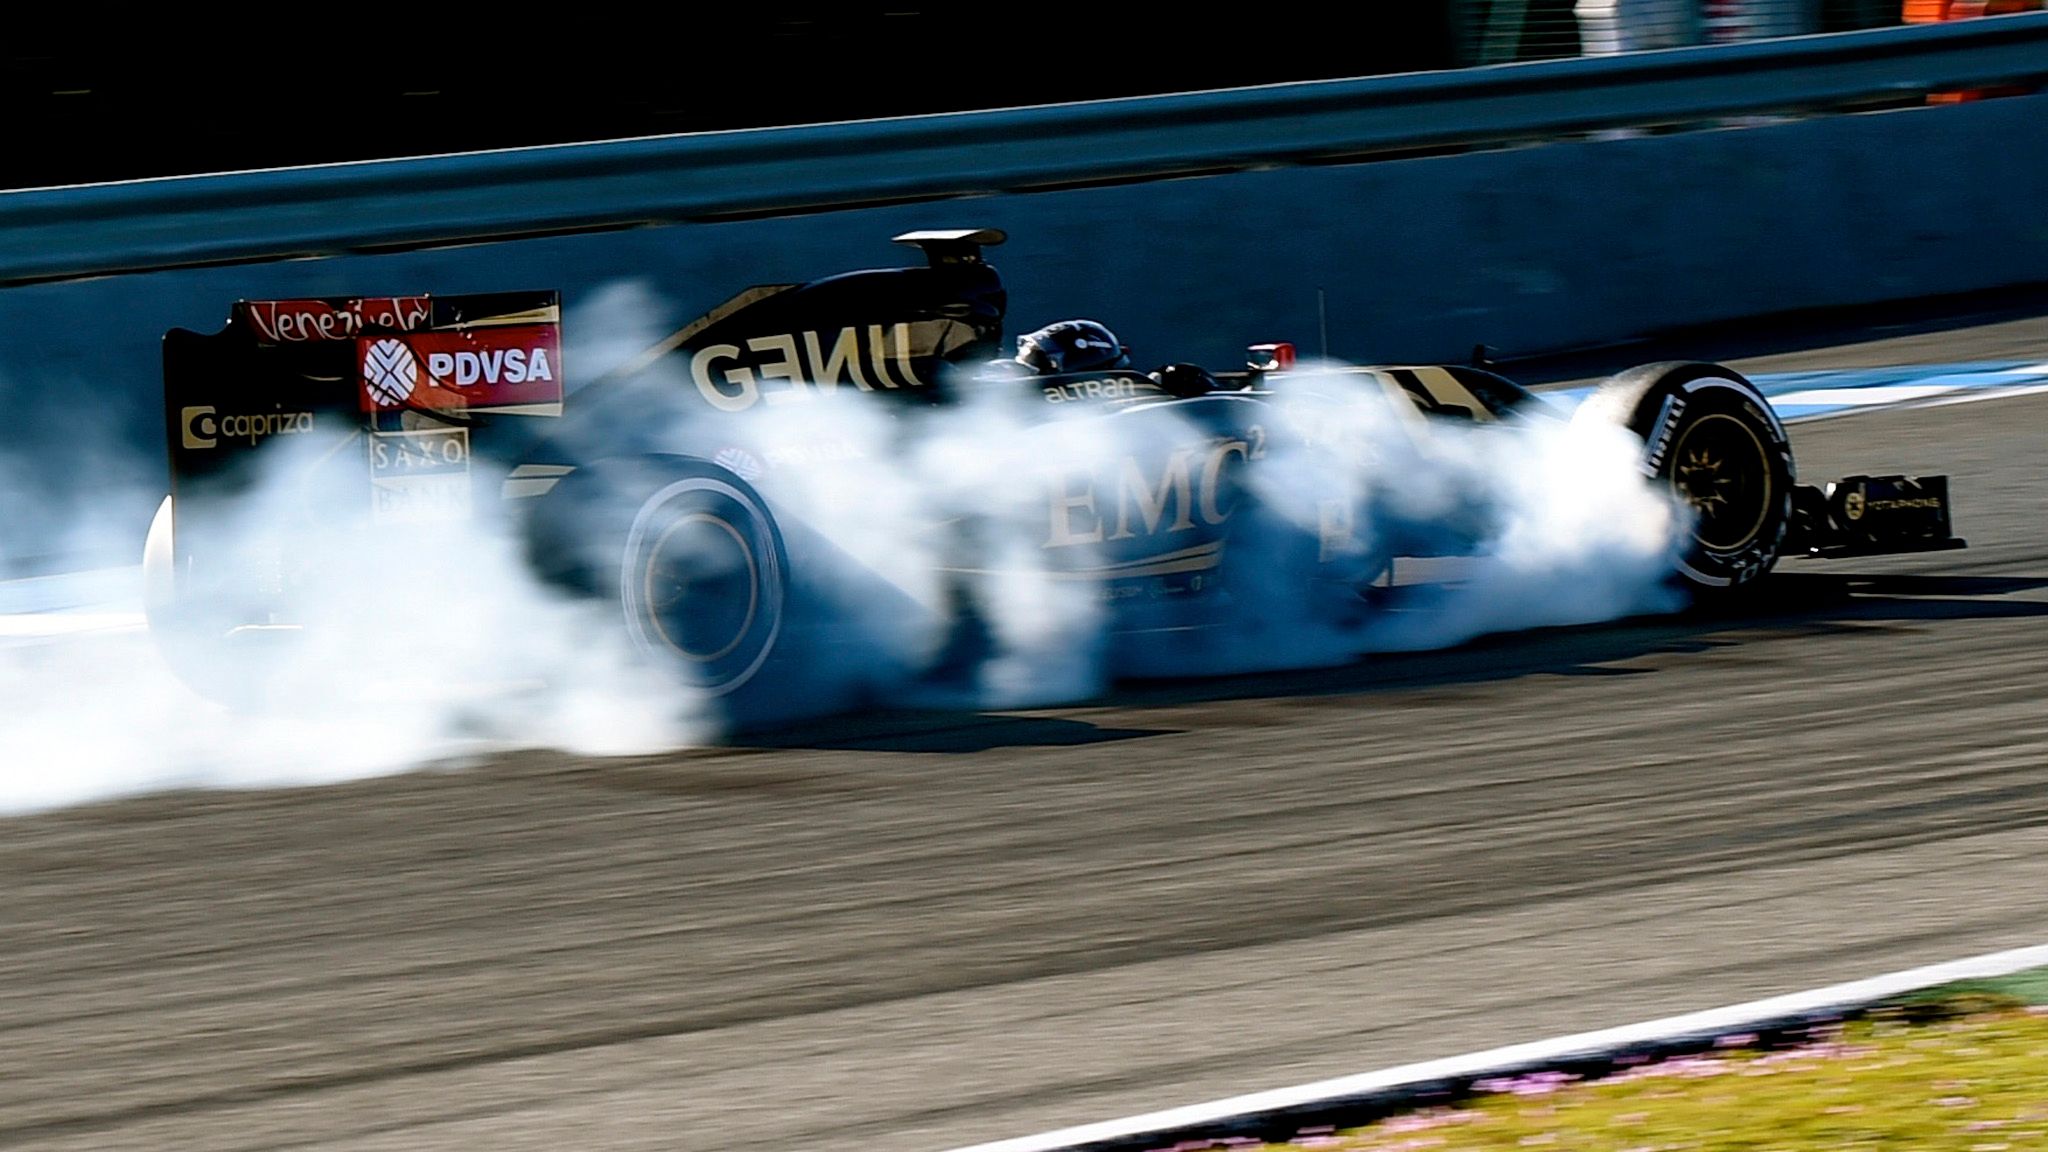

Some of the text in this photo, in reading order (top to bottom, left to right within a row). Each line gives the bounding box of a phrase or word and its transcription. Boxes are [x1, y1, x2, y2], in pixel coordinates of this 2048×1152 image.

[428, 347, 552, 387] PDVSA
[220, 403, 313, 446] capriza
[375, 439, 462, 469] SAXO
